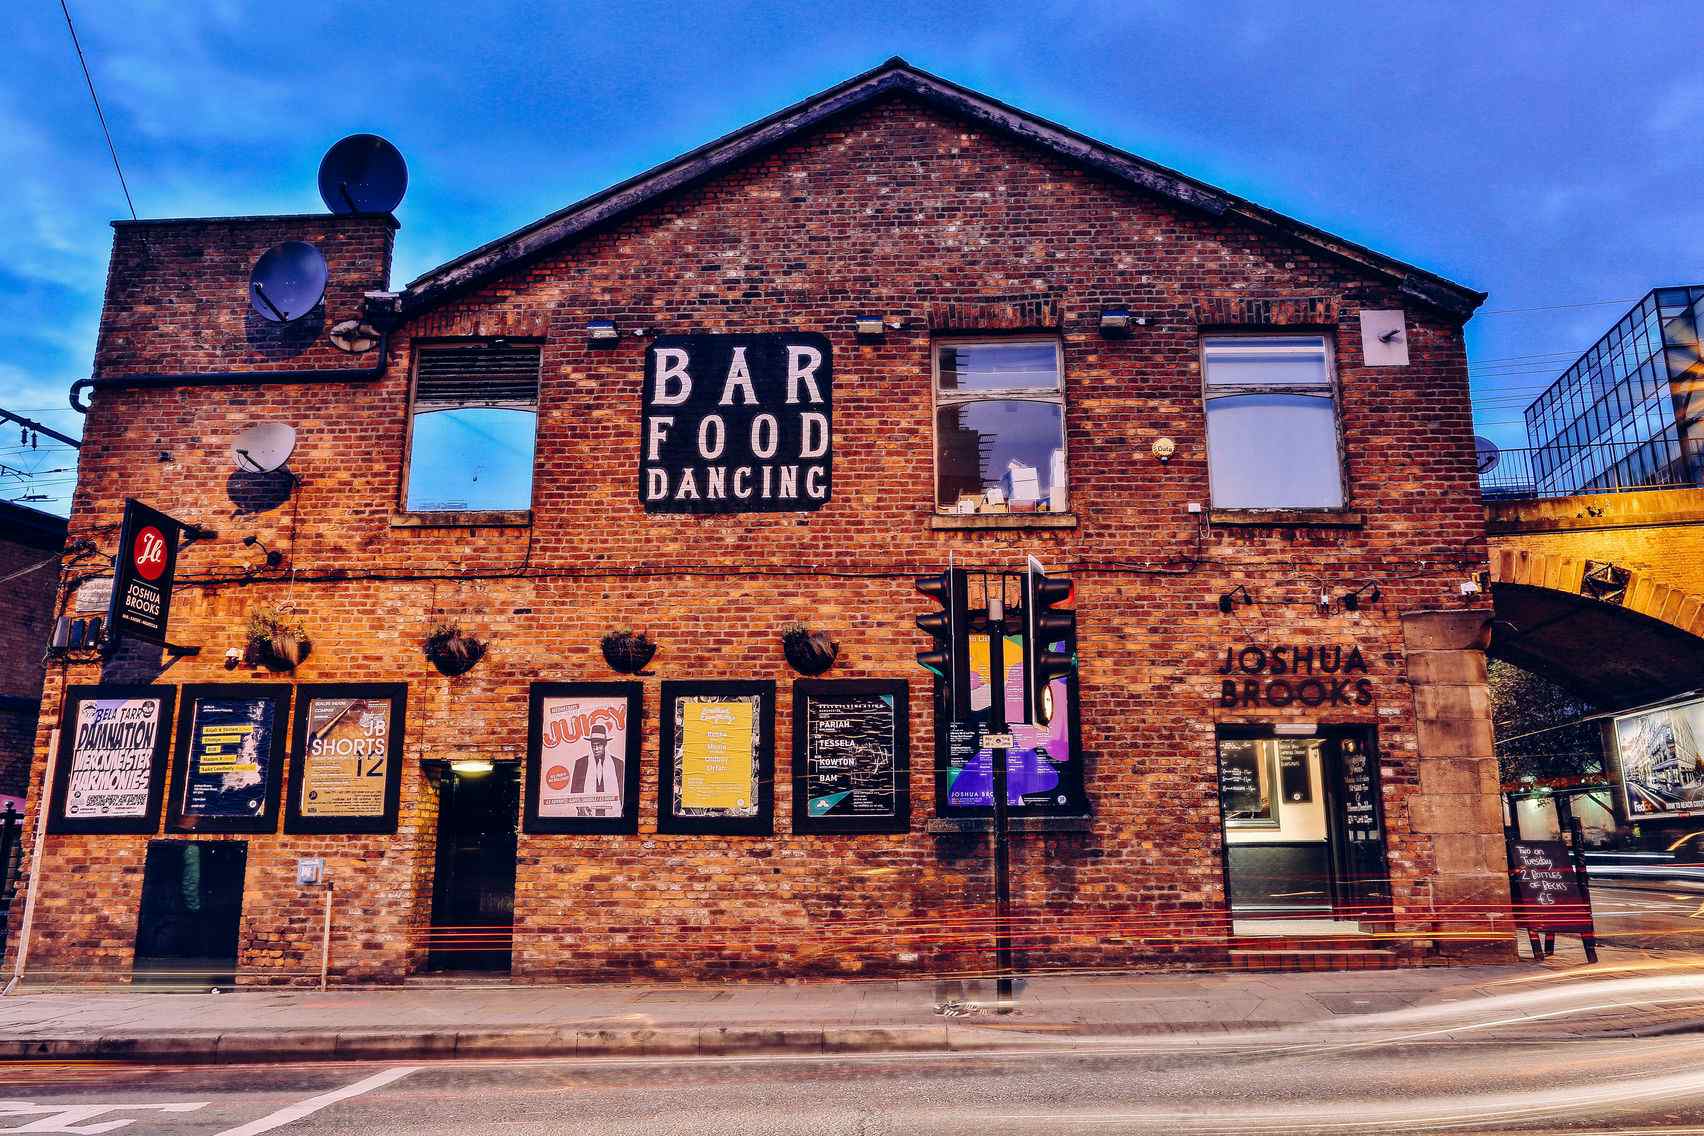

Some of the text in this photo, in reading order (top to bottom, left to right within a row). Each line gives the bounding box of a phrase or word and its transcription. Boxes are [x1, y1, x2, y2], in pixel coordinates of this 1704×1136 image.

[650, 346, 825, 406] BAR
[648, 412, 828, 461] FOOD
[648, 465, 827, 501] DANCING
[127, 584, 161, 604] JOSHUA
[125, 595, 160, 616] BROOKS
[1218, 645, 1368, 675] JOSHUA
[1220, 677, 1374, 708] BROOKS
[95, 708, 118, 723] BELA
[819, 721, 850, 729] PARIAH
[79, 721, 155, 750] DAMNATION
[364, 720, 385, 737] JB
[311, 739, 385, 756] SHORTS
[819, 740, 856, 748] TESSELA
[356, 750, 384, 777] 12
[819, 759, 856, 767] KOWTON
[72, 769, 150, 791] HARMONIES
[1521, 856, 1552, 870] Tuesday
[1520, 870, 1530, 879] 2
